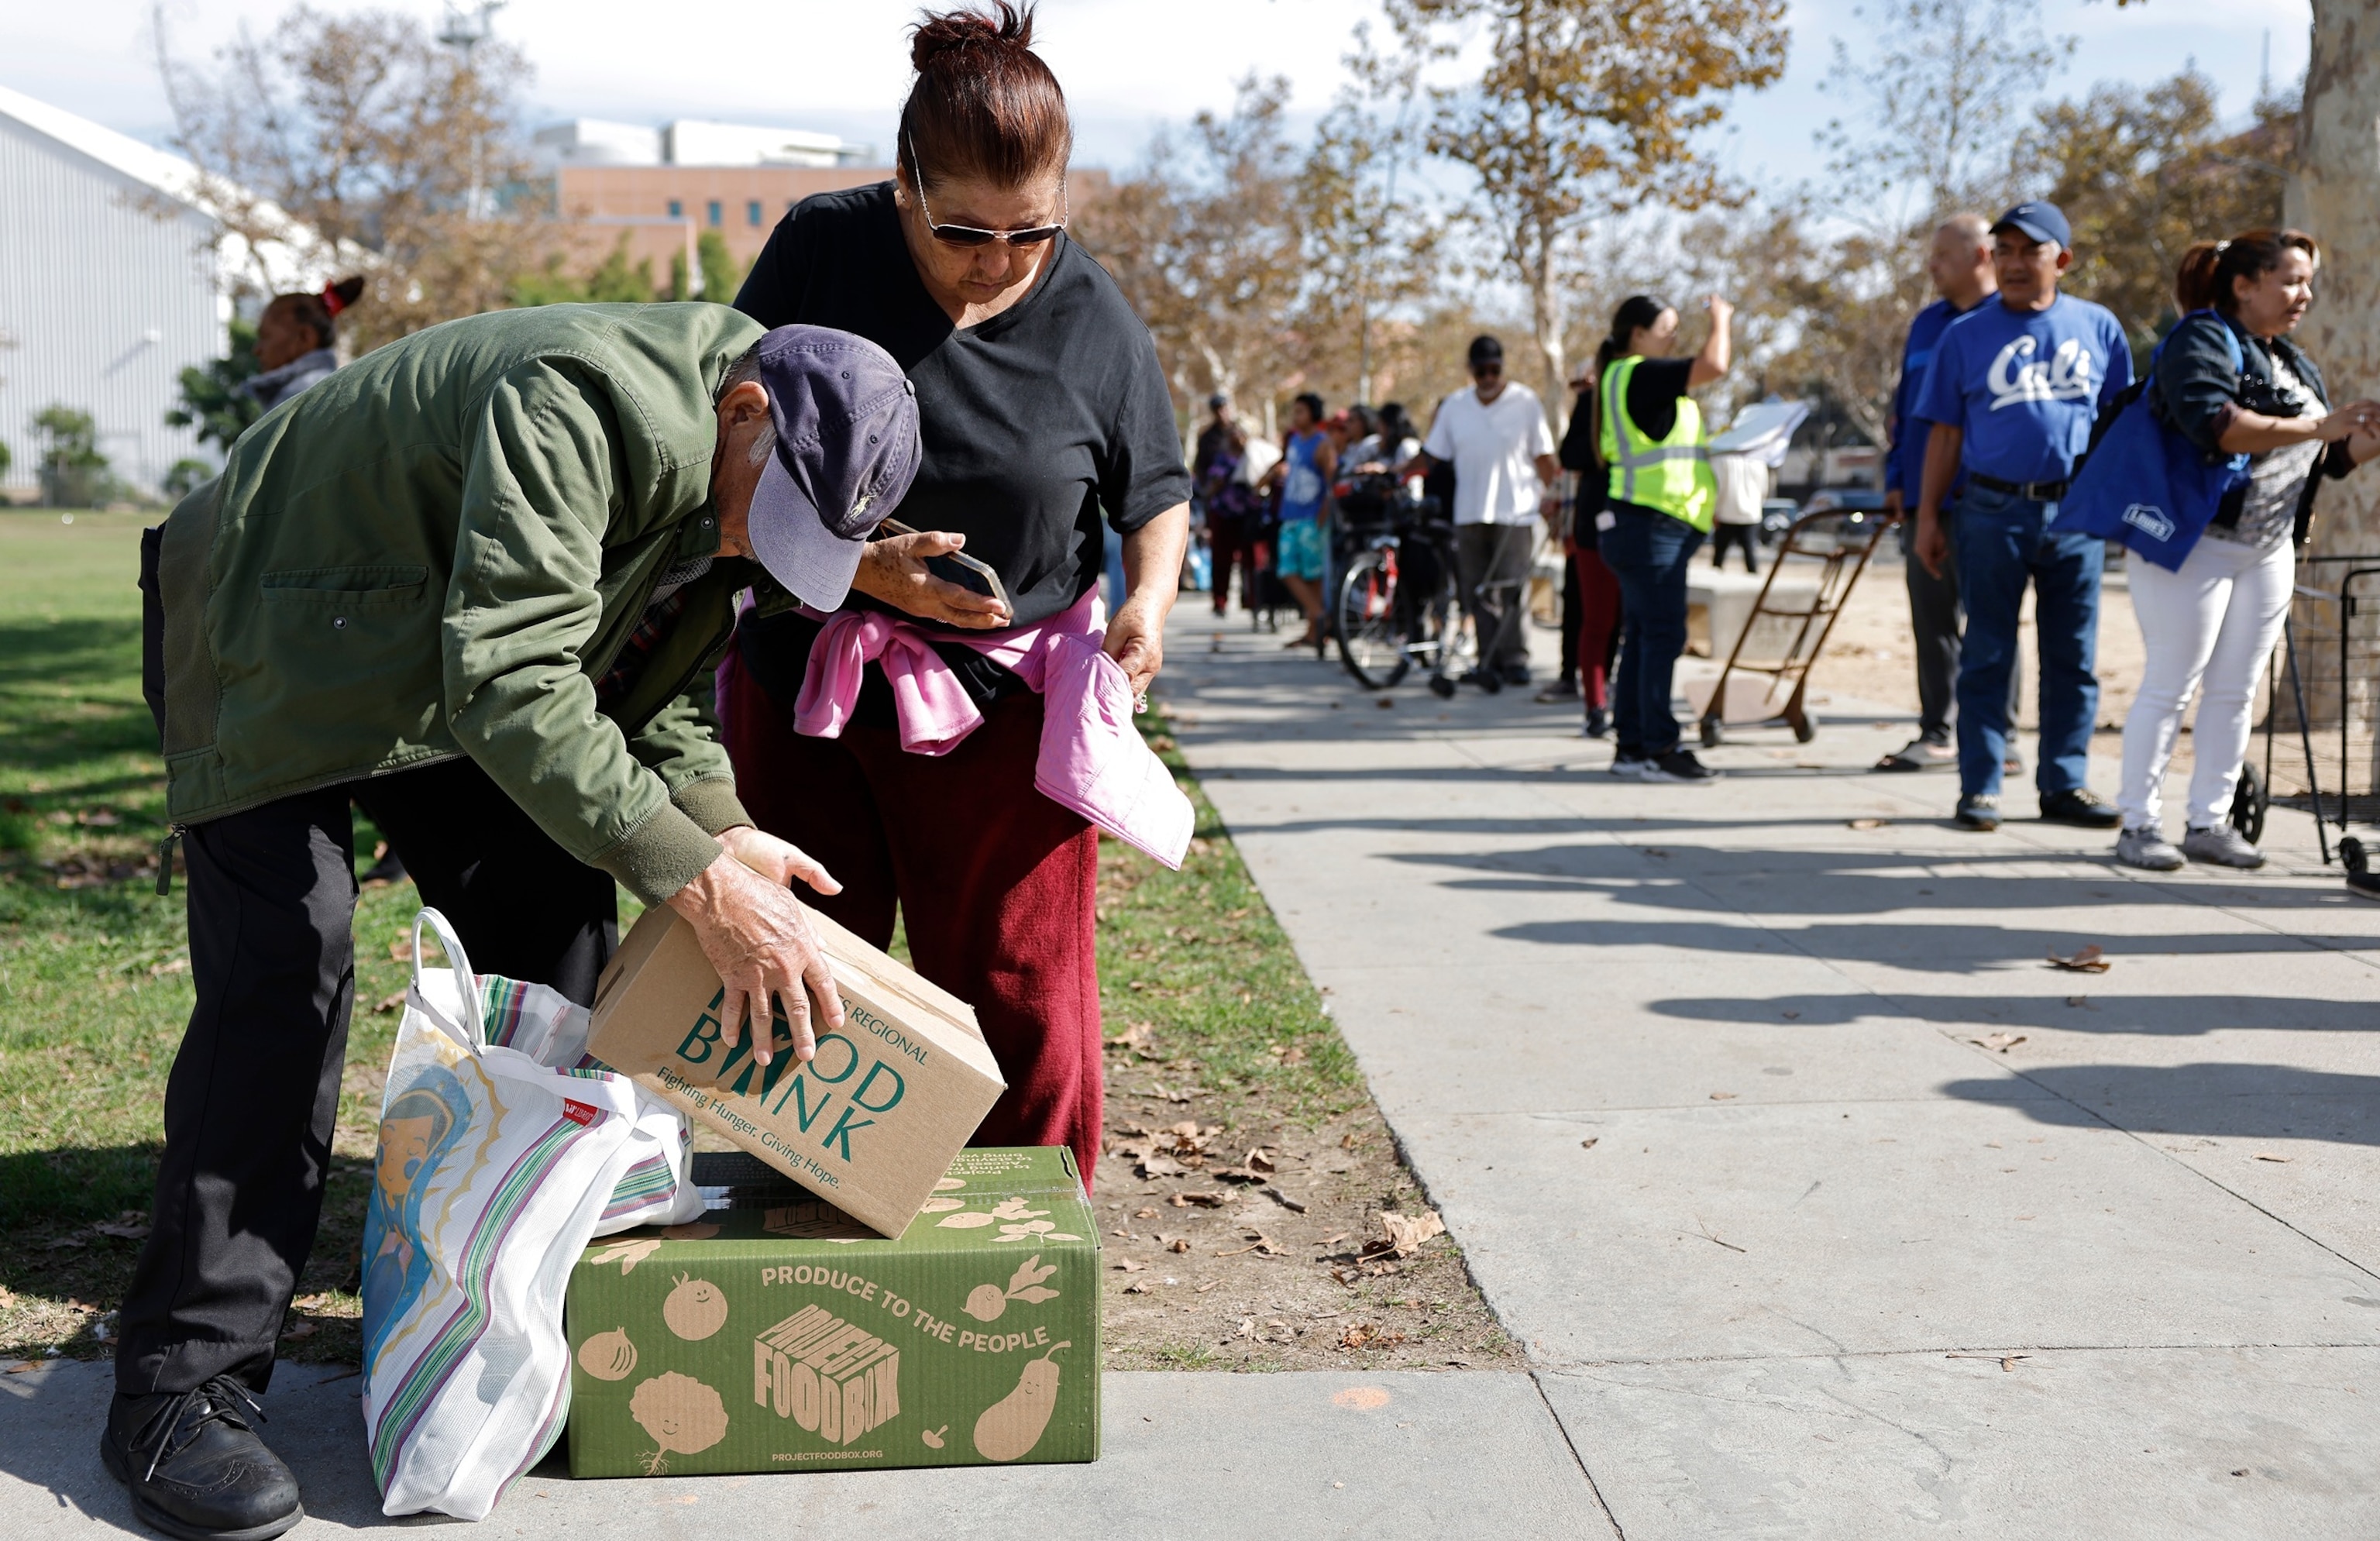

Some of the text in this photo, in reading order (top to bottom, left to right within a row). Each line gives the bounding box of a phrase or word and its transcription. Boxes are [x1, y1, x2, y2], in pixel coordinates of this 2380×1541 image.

[850, 1006, 930, 1066] REGIONAL
[657, 1066, 840, 1189] Fighting Hunger. Giving Hope.
[755, 1303, 899, 1381] PROJECT
[761, 1265, 1050, 1353] PRODUCE TO THE PEOPLE
[772, 1450, 882, 1462] PROJECTFOODBOX.ORG
